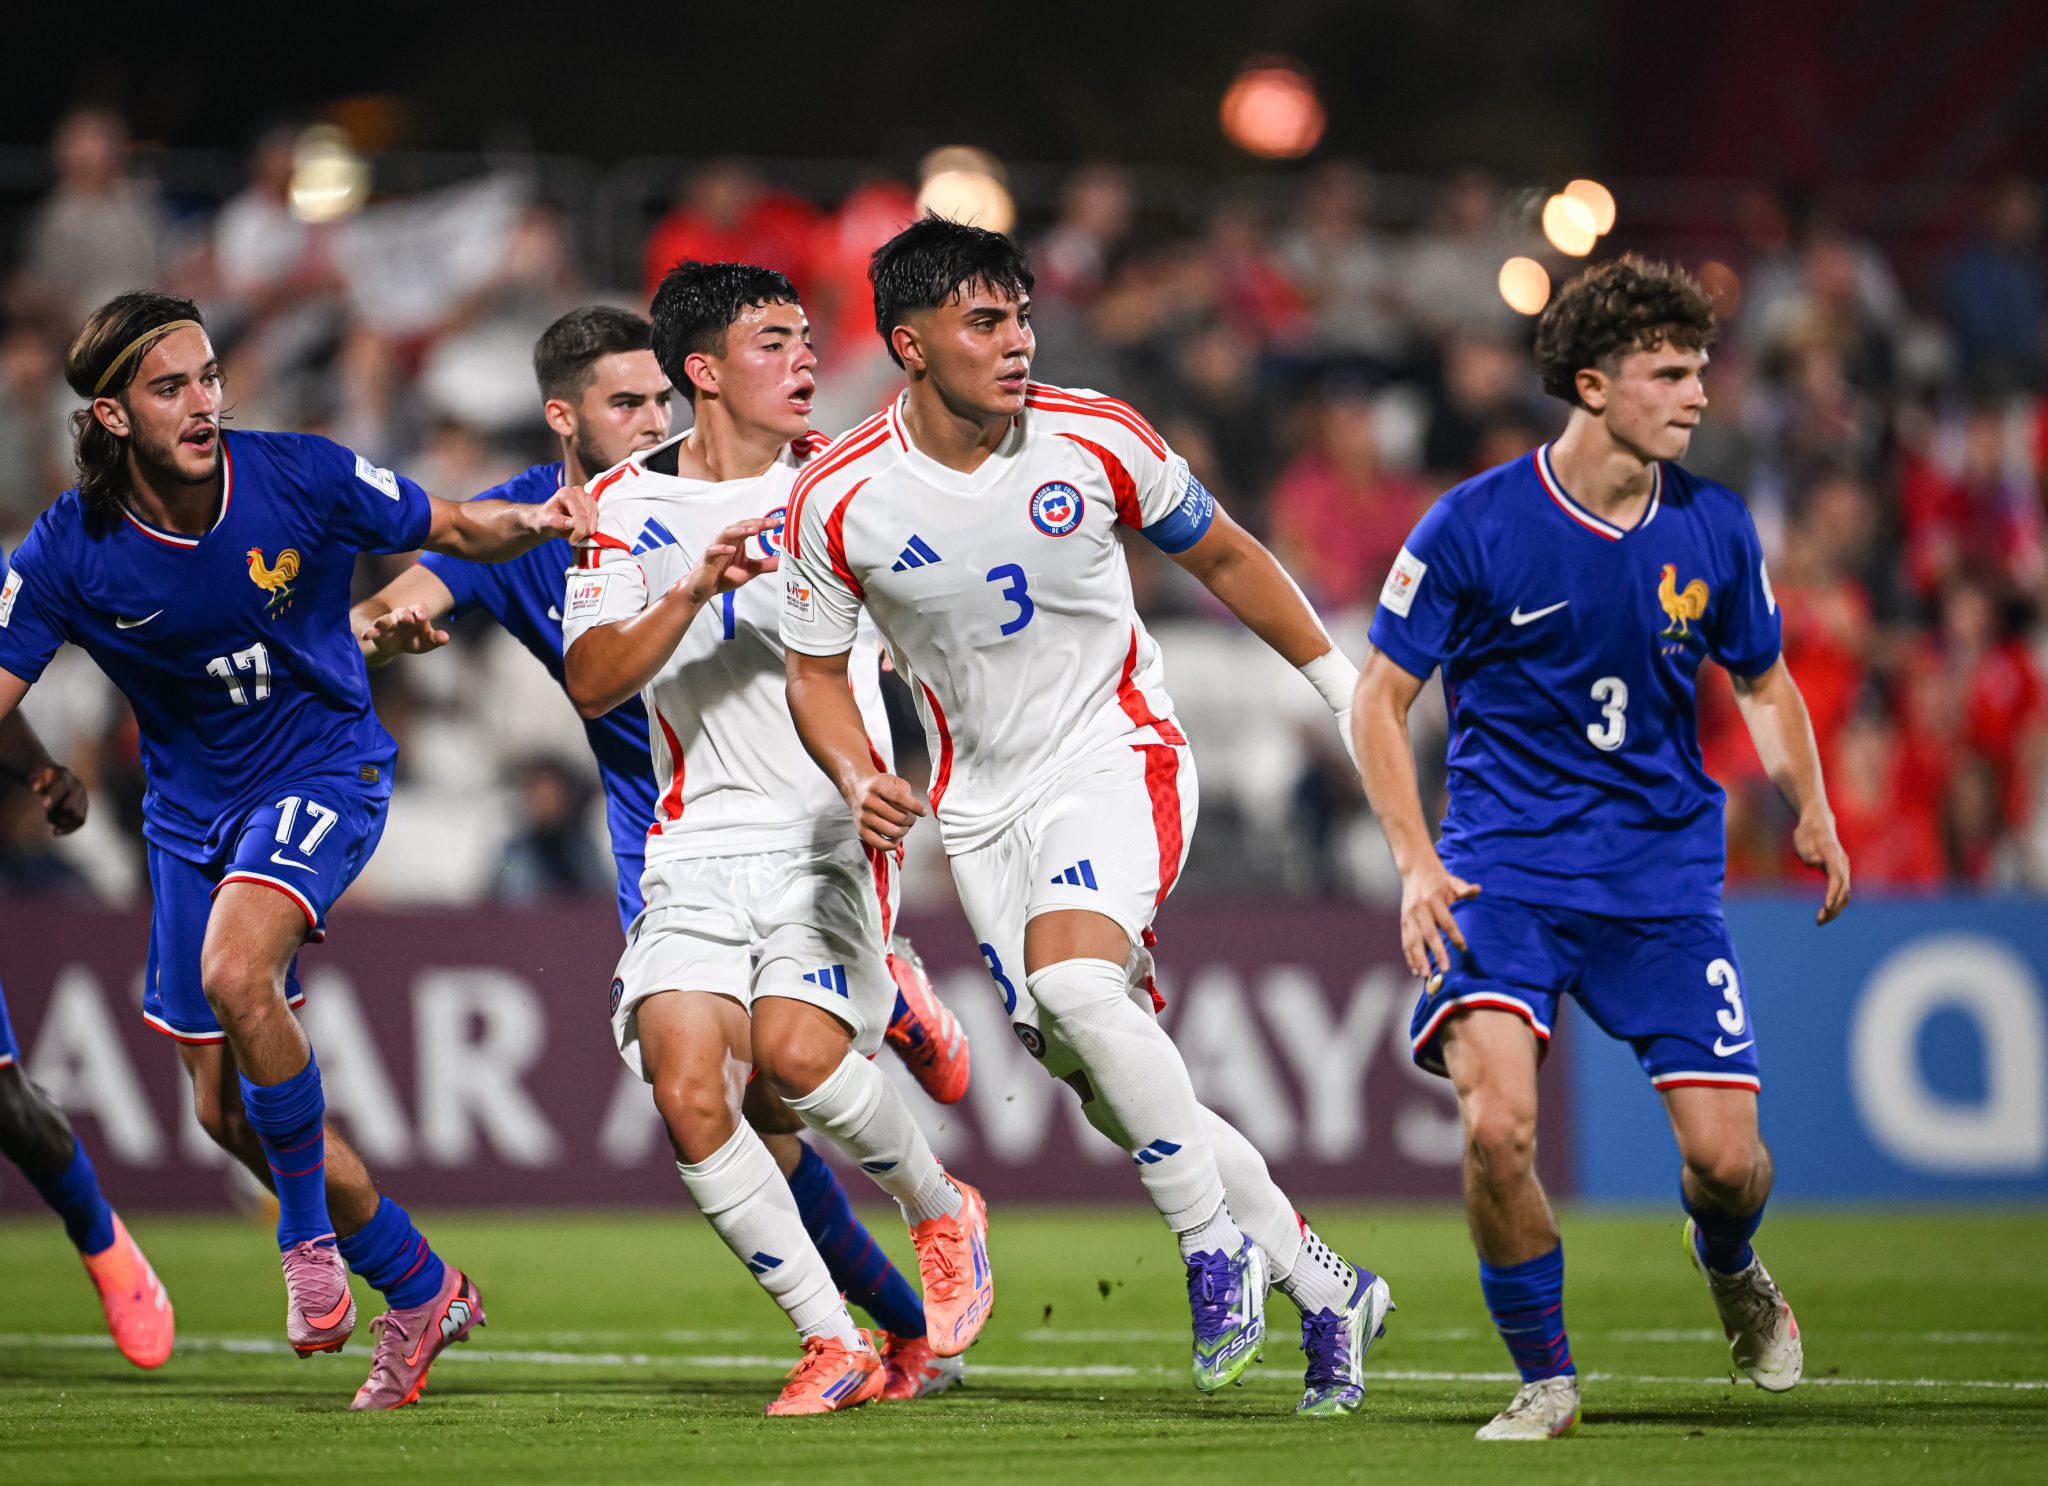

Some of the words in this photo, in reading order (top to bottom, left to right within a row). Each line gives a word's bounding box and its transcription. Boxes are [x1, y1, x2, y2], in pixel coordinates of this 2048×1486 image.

[1061, 520, 1077, 533] CHILE
[986, 563, 1035, 636] 3
[205, 641, 271, 706] 17
[1586, 676, 1629, 751] 3
[275, 795, 339, 856] 17
[1706, 957, 1746, 1035] 3
[954, 1284, 991, 1342] F50
[1215, 1321, 1259, 1372] F50
